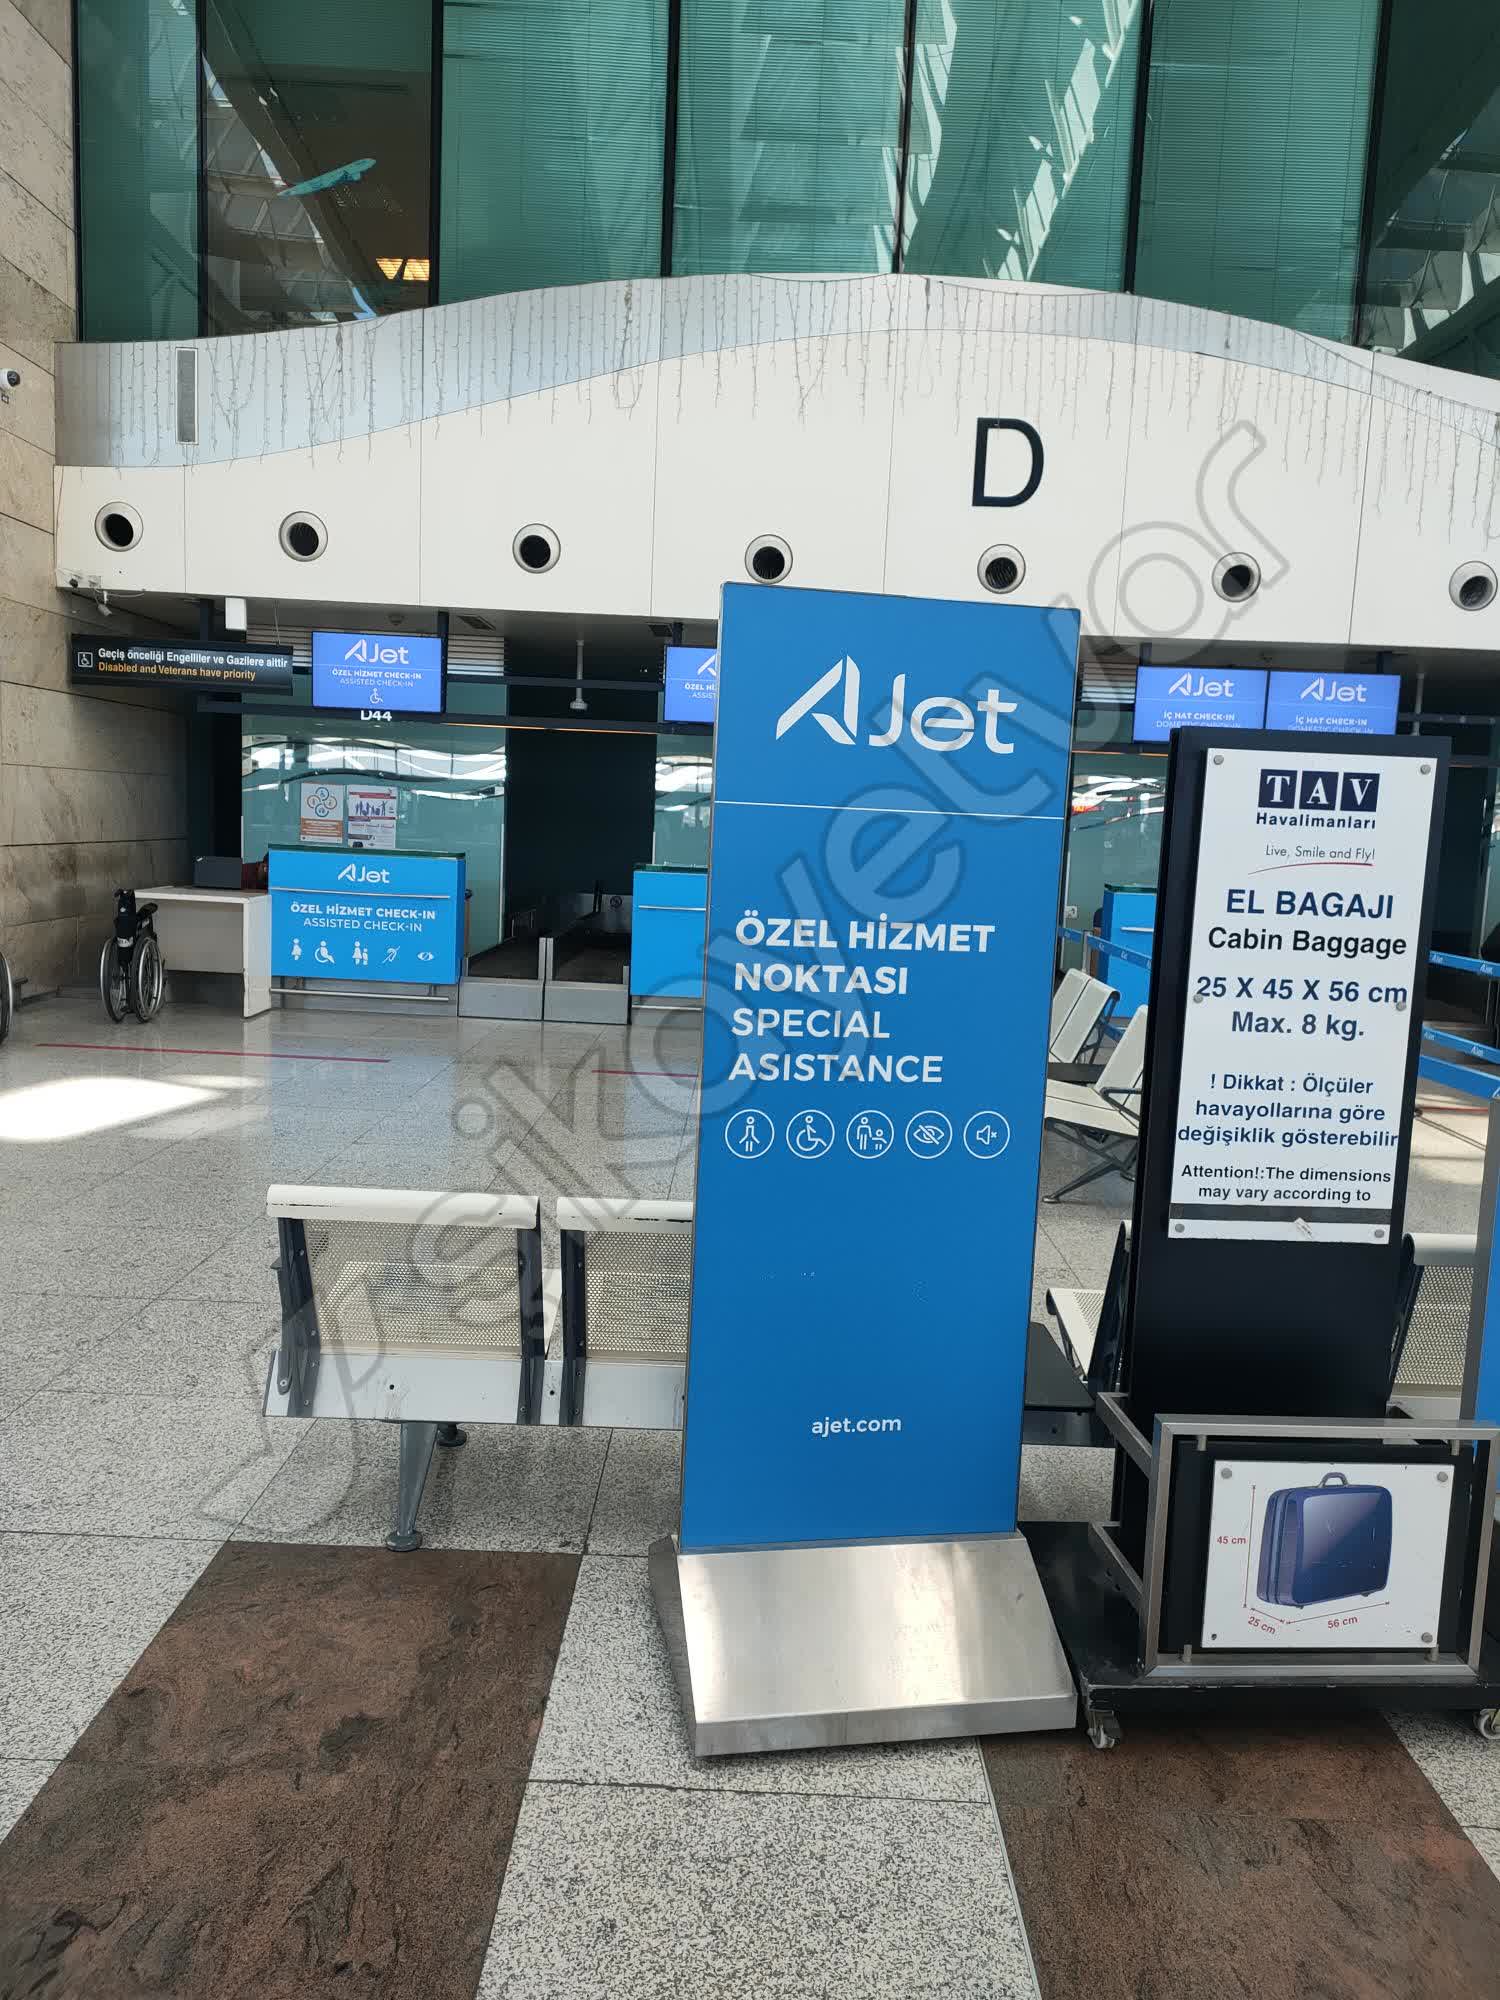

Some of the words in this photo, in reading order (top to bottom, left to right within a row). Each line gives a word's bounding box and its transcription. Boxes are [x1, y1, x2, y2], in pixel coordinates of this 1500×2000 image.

[971, 417, 1045, 508] D
[97, 647, 126, 666] Geçiş
[126, 648, 165, 666] önceliği
[212, 655, 225, 665] ve
[226, 655, 265, 670] Gazilere
[266, 657, 288, 668] aittir
[343, 637, 410, 665] AJet
[98, 660, 138, 673] Disabled
[139, 662, 157, 674] and
[158, 663, 198, 677] Veterans
[199, 665, 222, 679] have
[223, 667, 257, 682] priority
[331, 666, 353, 677] ÖZEL
[353, 667, 383, 679] HİZMET
[384, 671, 422, 680] CHECK-IN
[691, 690, 716, 699] ASSIST
[1168, 671, 1235, 698] AJet
[1300, 675, 1368, 703] AJet
[360, 709, 393, 722] D44
[775, 654, 1018, 755] AJet
[1193, 712, 1235, 722] CHECK-IN
[1325, 717, 1368, 727] CHECK-IN
[1256, 811, 1377, 830] Havalimanları
[1265, 844, 1290, 858] Live,
[1294, 845, 1326, 858] Smile
[1329, 847, 1352, 860] and
[1354, 847, 1376, 862] Fly!
[337, 863, 391, 884] AJet
[290, 901, 323, 914] ÖZEL
[325, 903, 373, 919] HİZMET
[375, 907, 436, 921] CHECK-IN
[1226, 888, 1265, 915] EL
[1275, 890, 1394, 919] BAGAJI
[303, 917, 361, 929] ASSISTED
[363, 920, 422, 933] CHECK-IN
[735, 909, 840, 949] ÖZEL
[848, 912, 996, 953] HİZMET
[1208, 926, 1283, 951] Cabin
[1292, 929, 1407, 960] Baggage
[734, 962, 908, 995] NOKTASI
[1195, 976, 1227, 999] 25
[1262, 978, 1294, 1000] 45
[1328, 980, 1360, 1003] 56
[1366, 984, 1408, 1004] cm
[731, 1007, 891, 1039] SPECIAL
[1231, 1010, 1292, 1034] Max.
[1301, 1014, 1317, 1035] 8
[1325, 1015, 1364, 1042] kg.
[728, 1052, 944, 1083] ASISTANCE
[1223, 1074, 1284, 1092] Dikkat
[1302, 1073, 1374, 1097] Ölçüler
[1195, 1100, 1332, 1121] havayollarına
[1339, 1106, 1386, 1124] göre
[1177, 1126, 1276, 1147] değişiklik
[1281, 1132, 1400, 1149] gösterebilir
[1299, 1167, 1391, 1183] dimensions
[1198, 1187, 1231, 1201] may
[1235, 1188, 1269, 1202] vary
[1273, 1188, 1351, 1204] according
[1356, 1190, 1371, 1202] to
[811, 1416, 902, 1438] ajet.com
[1216, 1535, 1229, 1545] 45
[1231, 1537, 1247, 1545] cm
[1247, 1616, 1260, 1628] 25
[1260, 1622, 1277, 1635] cm
[1327, 1617, 1341, 1630] 56
[1342, 1615, 1359, 1626] cm
